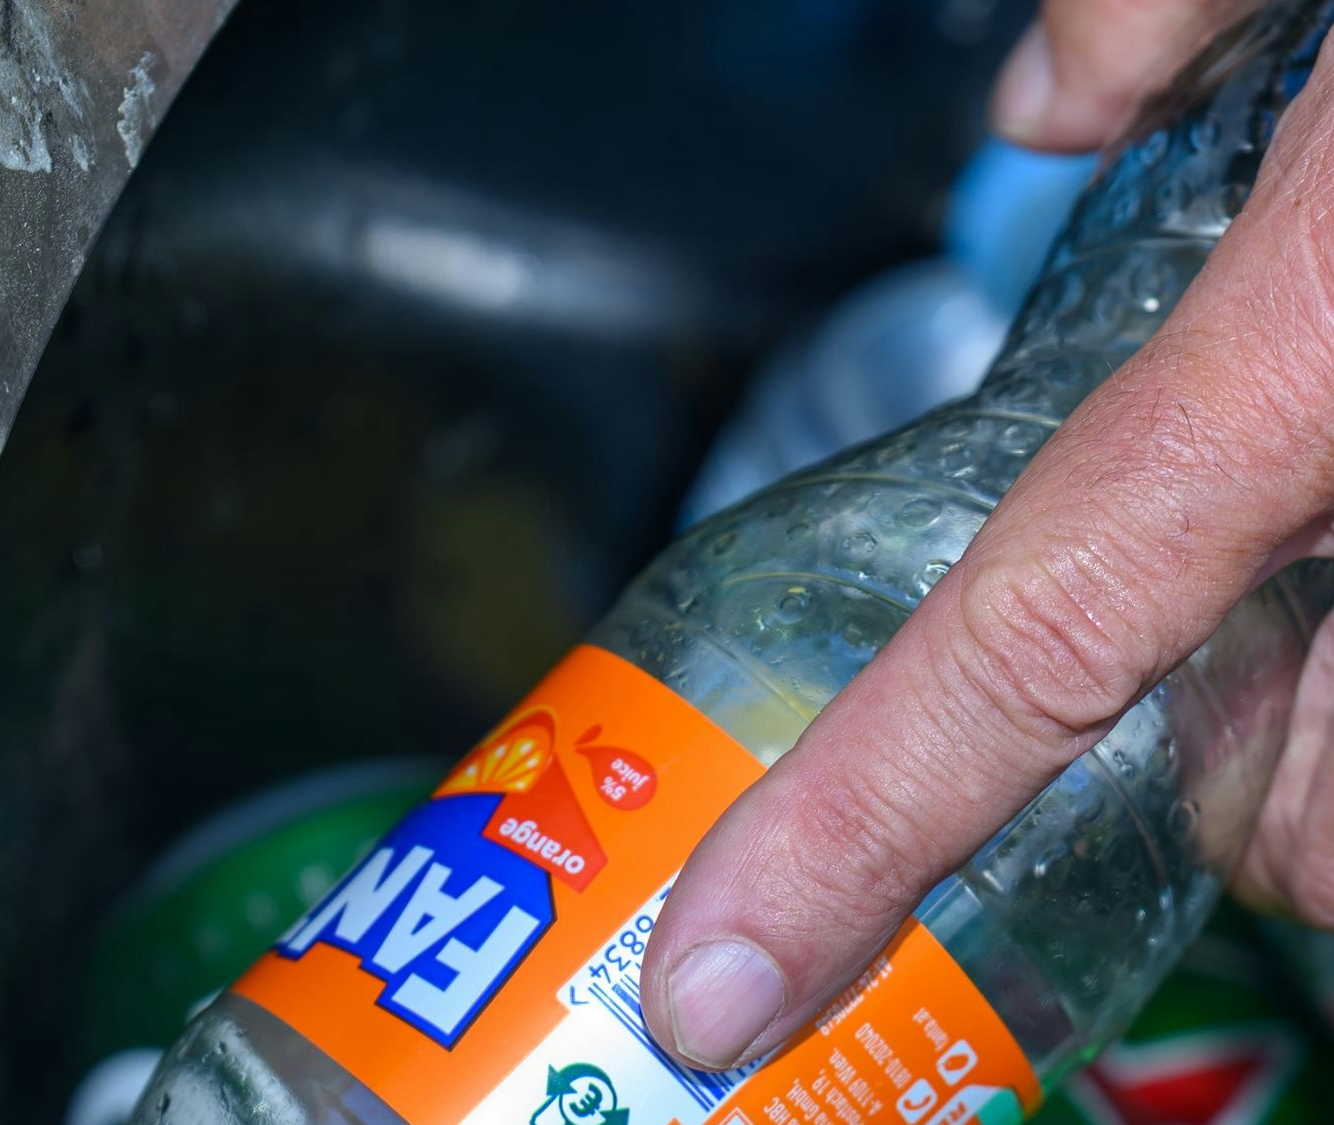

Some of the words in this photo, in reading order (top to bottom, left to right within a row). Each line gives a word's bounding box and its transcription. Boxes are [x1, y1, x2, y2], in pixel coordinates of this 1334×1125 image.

[600, 776, 626, 801] 5%
[611, 758, 650, 791] juice
[499, 818, 585, 874] orange
[276, 845, 540, 1035] FAN
[912, 1008, 949, 1052] fanta.at
[829, 1048, 857, 1087] Wien.
[786, 1079, 820, 1122] GmbH,
